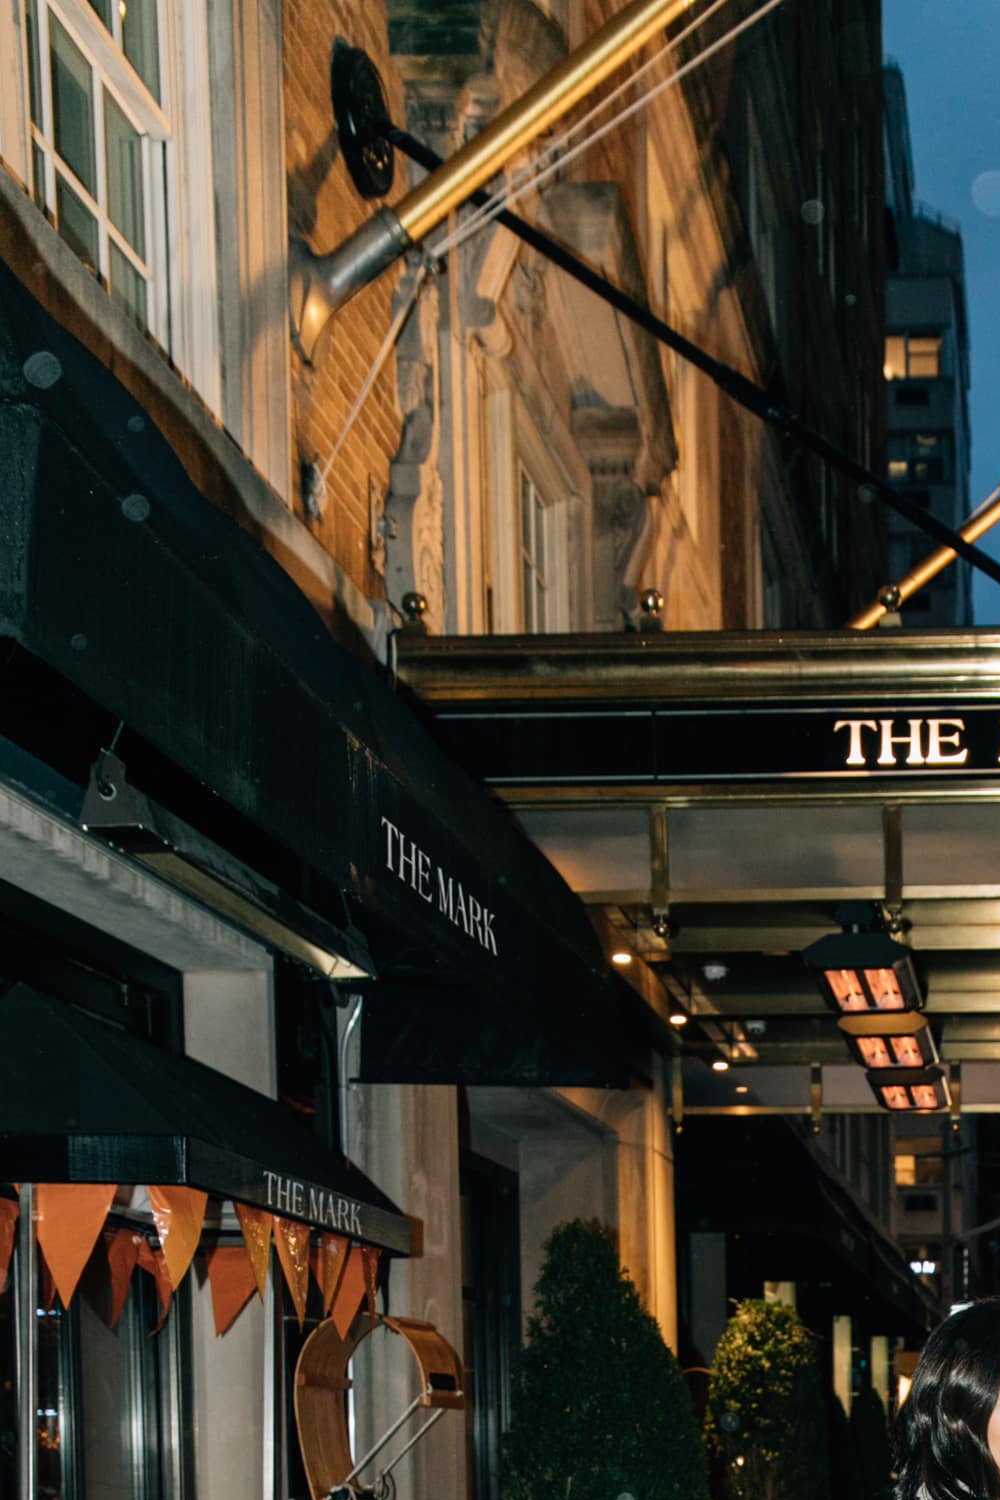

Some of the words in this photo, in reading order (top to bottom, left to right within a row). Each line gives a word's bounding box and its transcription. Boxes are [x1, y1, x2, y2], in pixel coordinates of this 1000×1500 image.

[832, 717, 969, 765] THE
[380, 815, 433, 904] THE
[437, 864, 499, 958] MARK
[262, 1169, 305, 1217] THE
[308, 1187, 363, 1236] MARK
